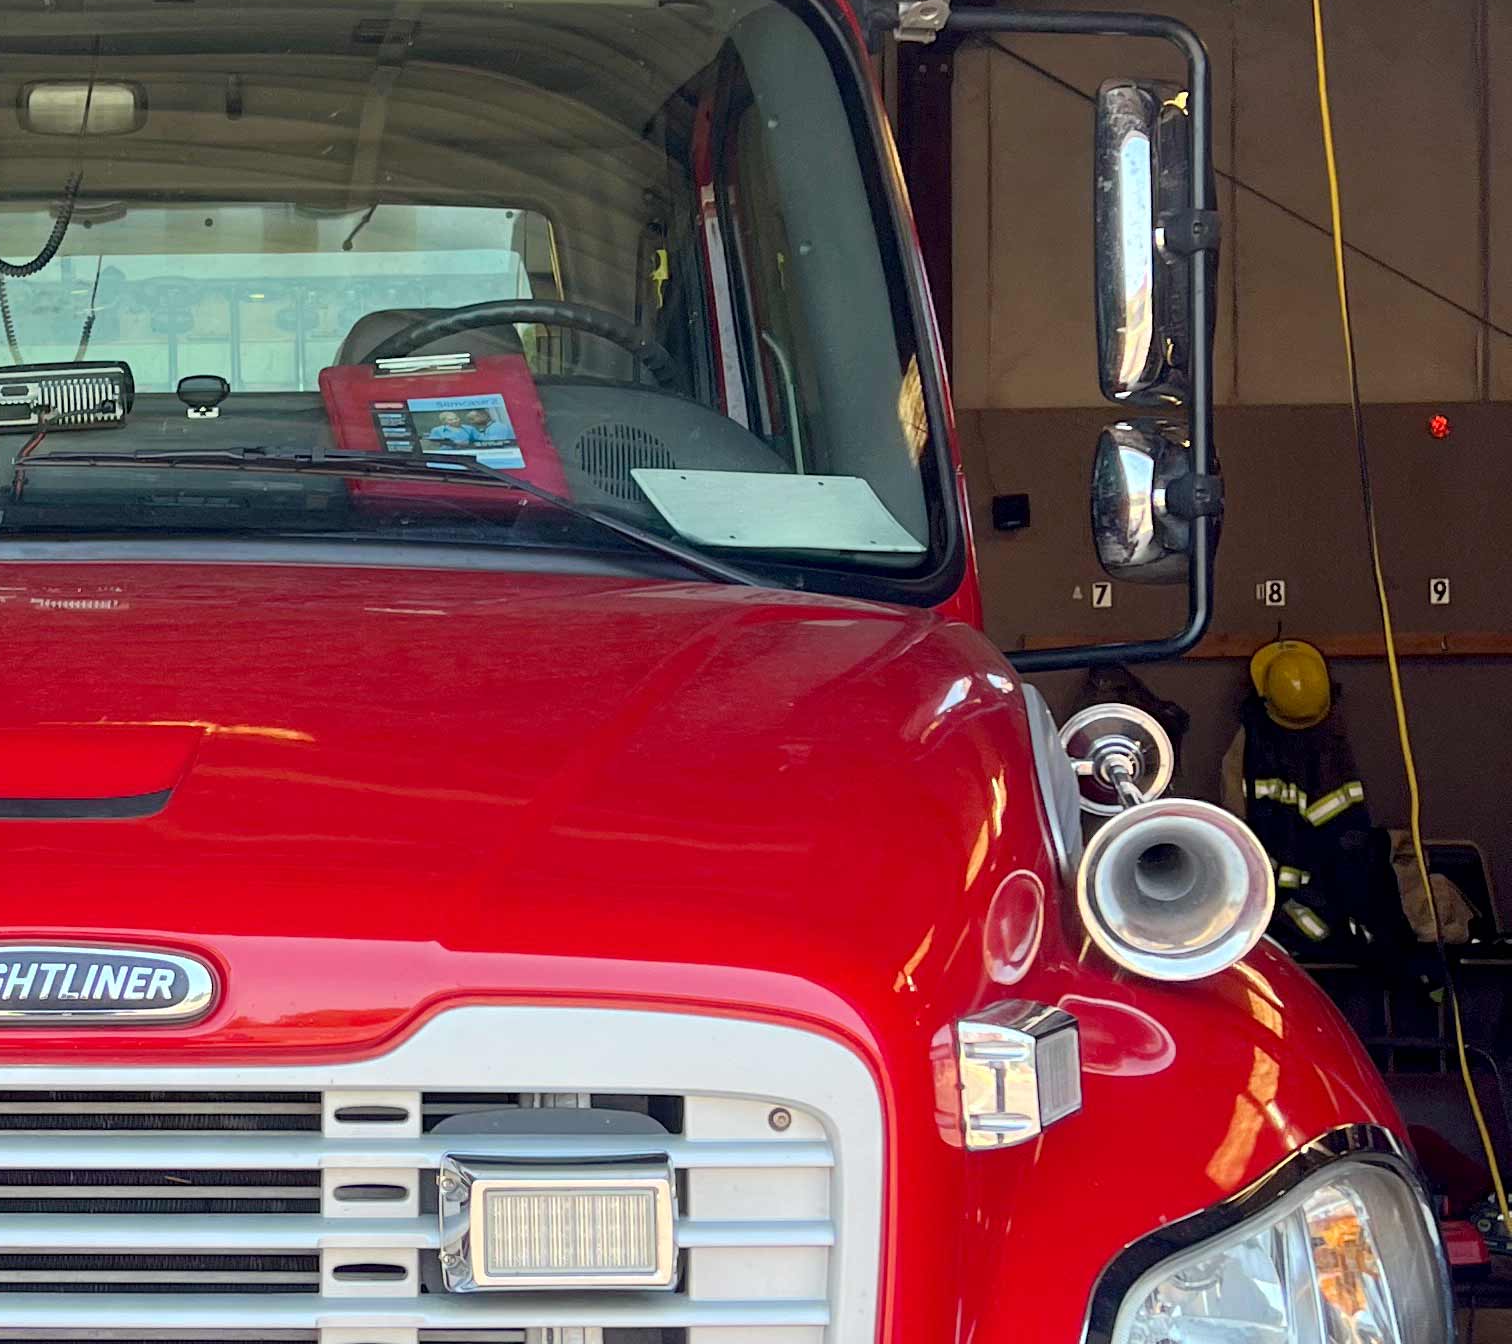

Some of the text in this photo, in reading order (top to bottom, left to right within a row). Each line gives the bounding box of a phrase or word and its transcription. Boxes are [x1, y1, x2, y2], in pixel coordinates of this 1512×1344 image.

[1095, 584, 1108, 605] 7
[1269, 582, 1282, 603] 8
[1433, 580, 1447, 602] 9
